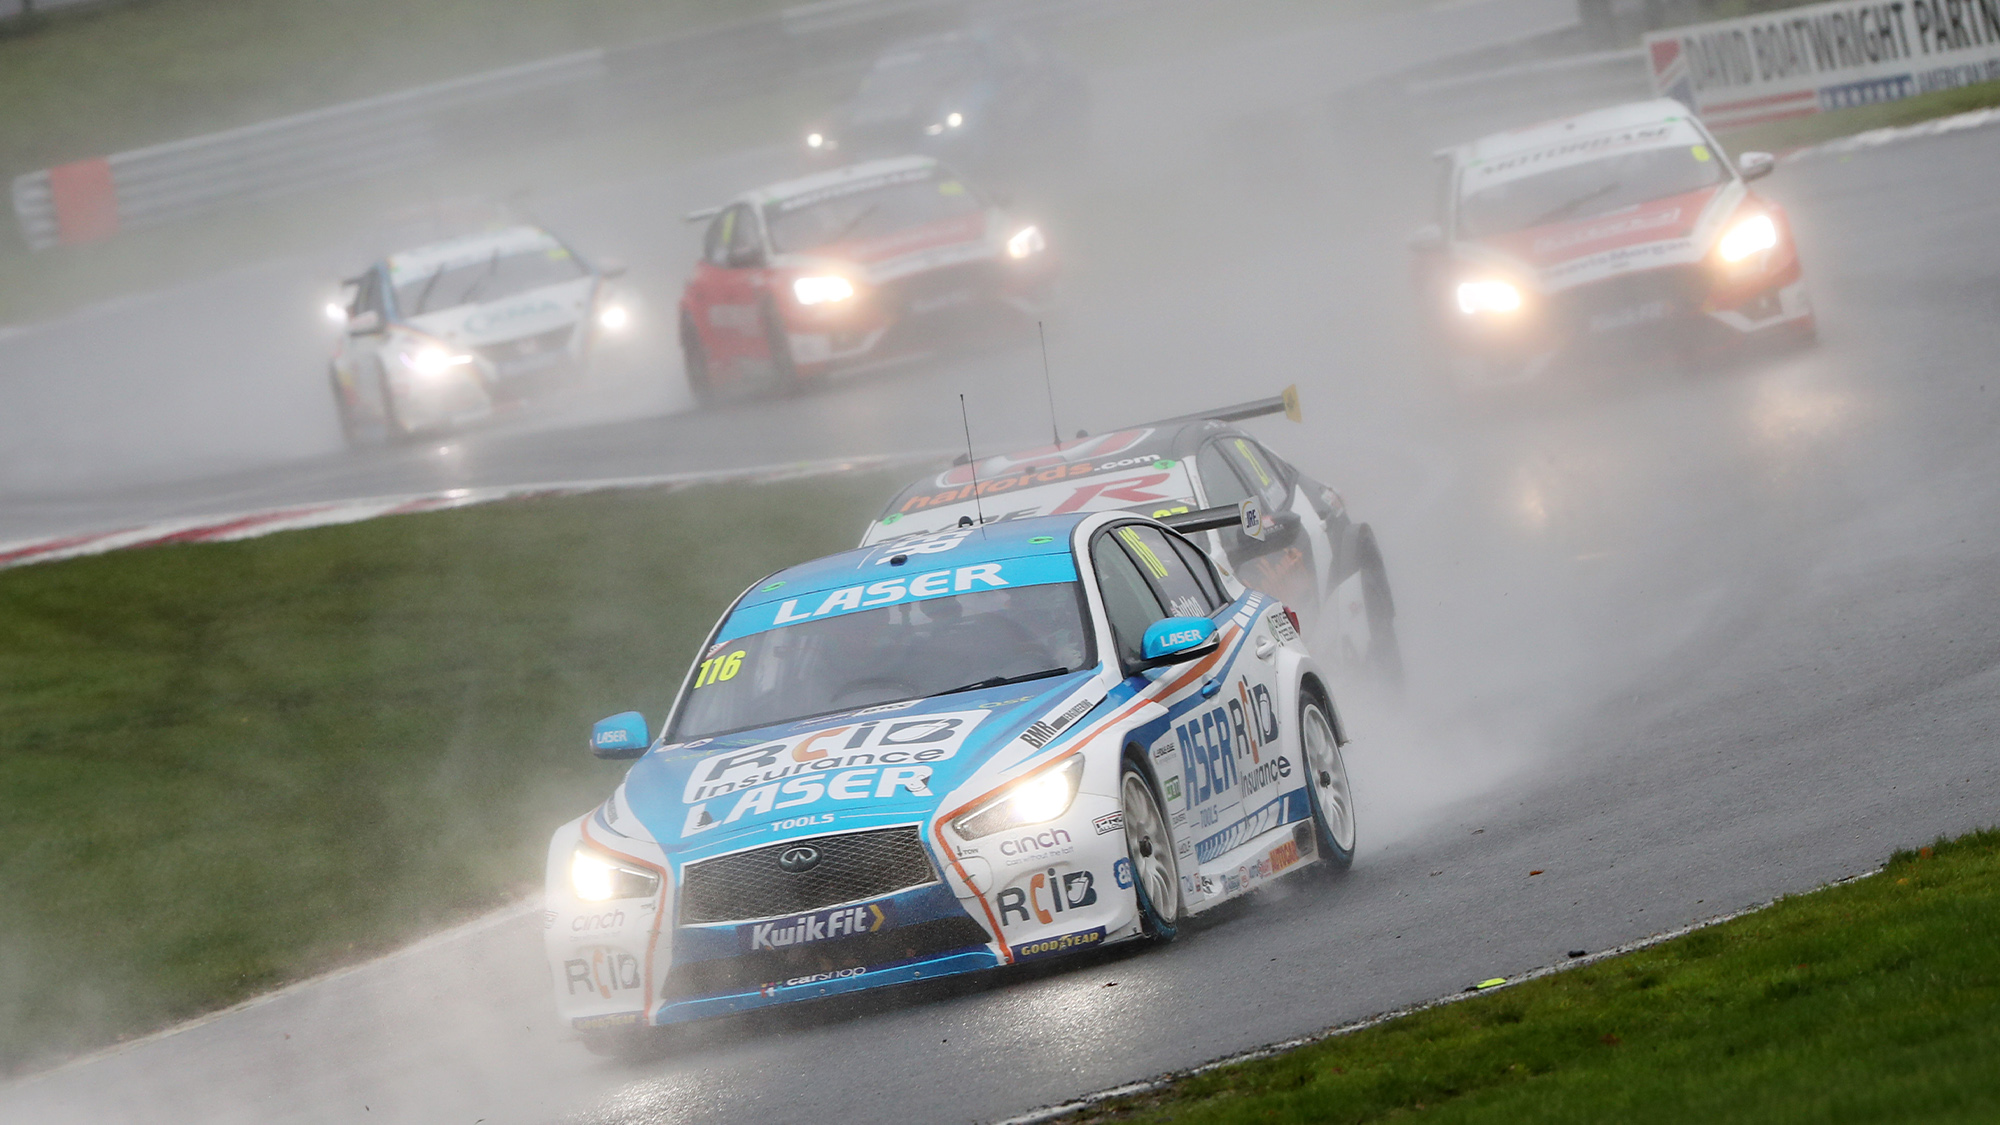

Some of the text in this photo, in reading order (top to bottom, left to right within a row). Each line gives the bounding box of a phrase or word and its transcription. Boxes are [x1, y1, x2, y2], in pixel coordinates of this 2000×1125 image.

[1684, 29, 1751, 92] DAVID
[1751, 3, 1911, 82] BOATWRIGHT
[902, 454, 1160, 512] halfords.com
[773, 563, 1009, 625] LASER
[1160, 629, 1203, 648] LASER
[694, 650, 746, 689] 116
[597, 729, 628, 744] LASER
[1020, 720, 1057, 750] BMR
[694, 749, 945, 801] Insurance
[1241, 756, 1291, 799] Insurance
[680, 765, 934, 838] LASER
[771, 814, 835, 831] TOOLS
[1000, 828, 1072, 856] cinch
[572, 909, 625, 932] cinch
[1021, 931, 1099, 956] GOODYEAR
